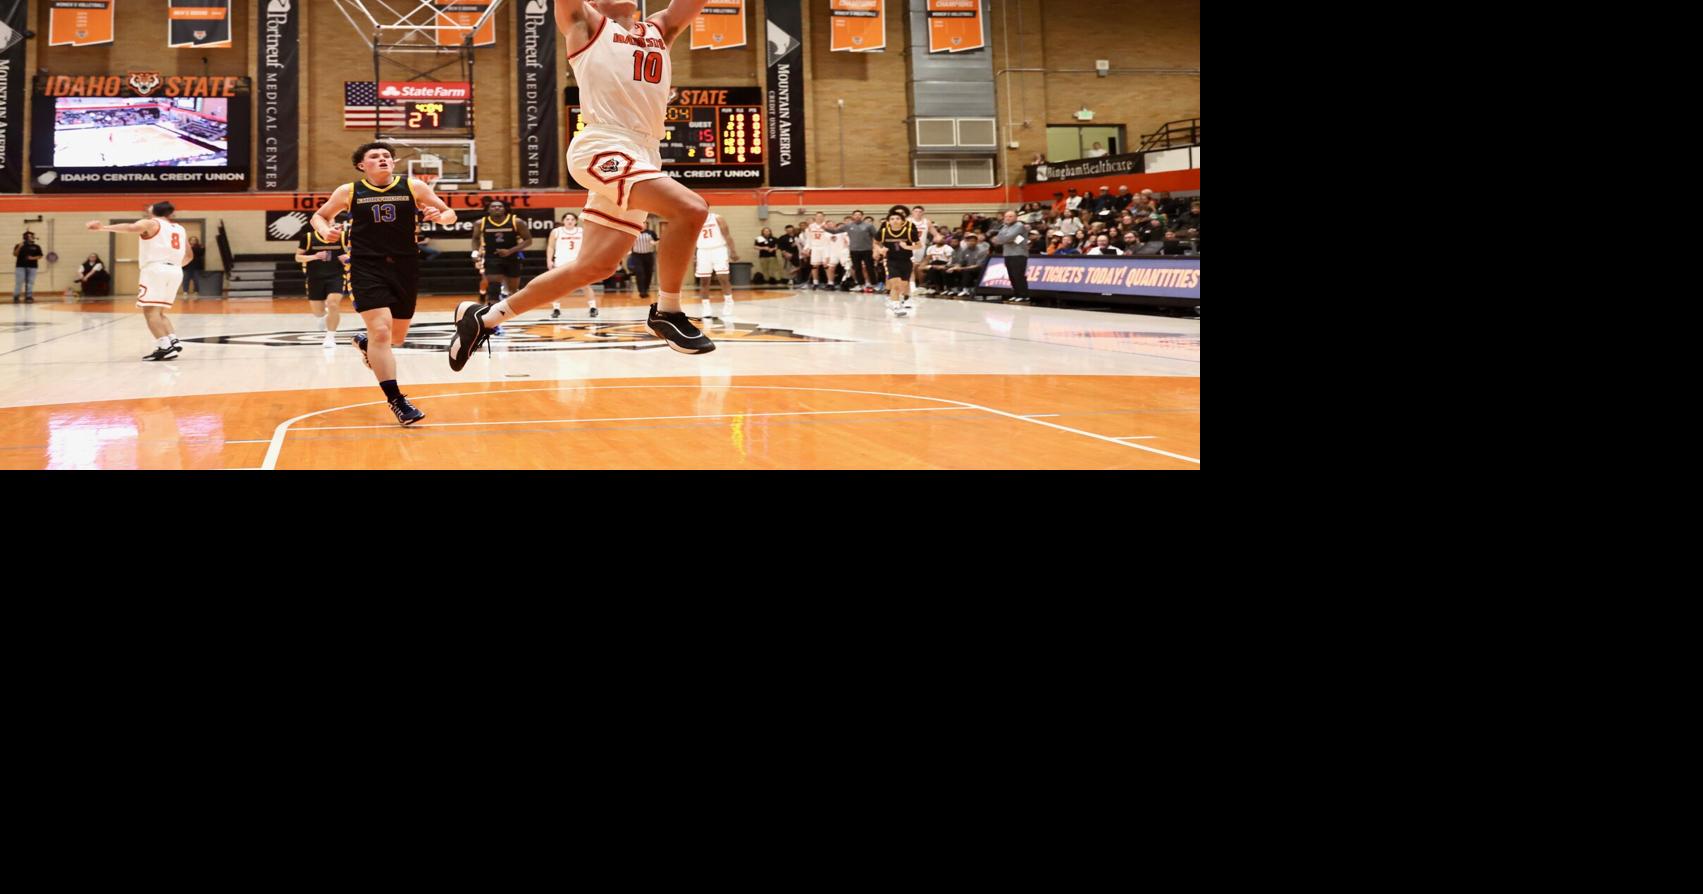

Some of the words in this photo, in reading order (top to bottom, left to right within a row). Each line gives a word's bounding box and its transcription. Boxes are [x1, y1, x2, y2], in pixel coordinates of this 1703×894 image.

[265, 12, 287, 69] Portneuf
[525, 14, 545, 68] Portneuf
[632, 49, 663, 84] 10
[44, 76, 122, 97] IDAHO
[165, 75, 240, 97] STATE
[777, 64, 790, 119] MOUNTAIN
[265, 73, 277, 131] MEDICAL
[526, 73, 537, 130] MEDICAL
[680, 90, 728, 105] STATE
[408, 112, 439, 128] 27
[698, 128, 714, 142] 15
[779, 120, 792, 167] AMERICA
[265, 137, 277, 188] CENTER
[527, 135, 539, 185] CENTER
[704, 147, 715, 158] 6
[60, 173, 100, 182] IDAHO
[102, 173, 157, 182] CENTRAL
[159, 173, 203, 182] CREDIT
[205, 172, 245, 181] UNION
[683, 170, 722, 178] CREDIT
[724, 170, 760, 178] UNION
[371, 203, 397, 223] 13
[171, 232, 180, 250] 8
[702, 228, 713, 239] 21
[569, 240, 575, 250] 3
[1042, 266, 1085, 283] TICKETS
[1085, 265, 1128, 285] TODAY!
[1125, 268, 1200, 289] QUANTITIES
